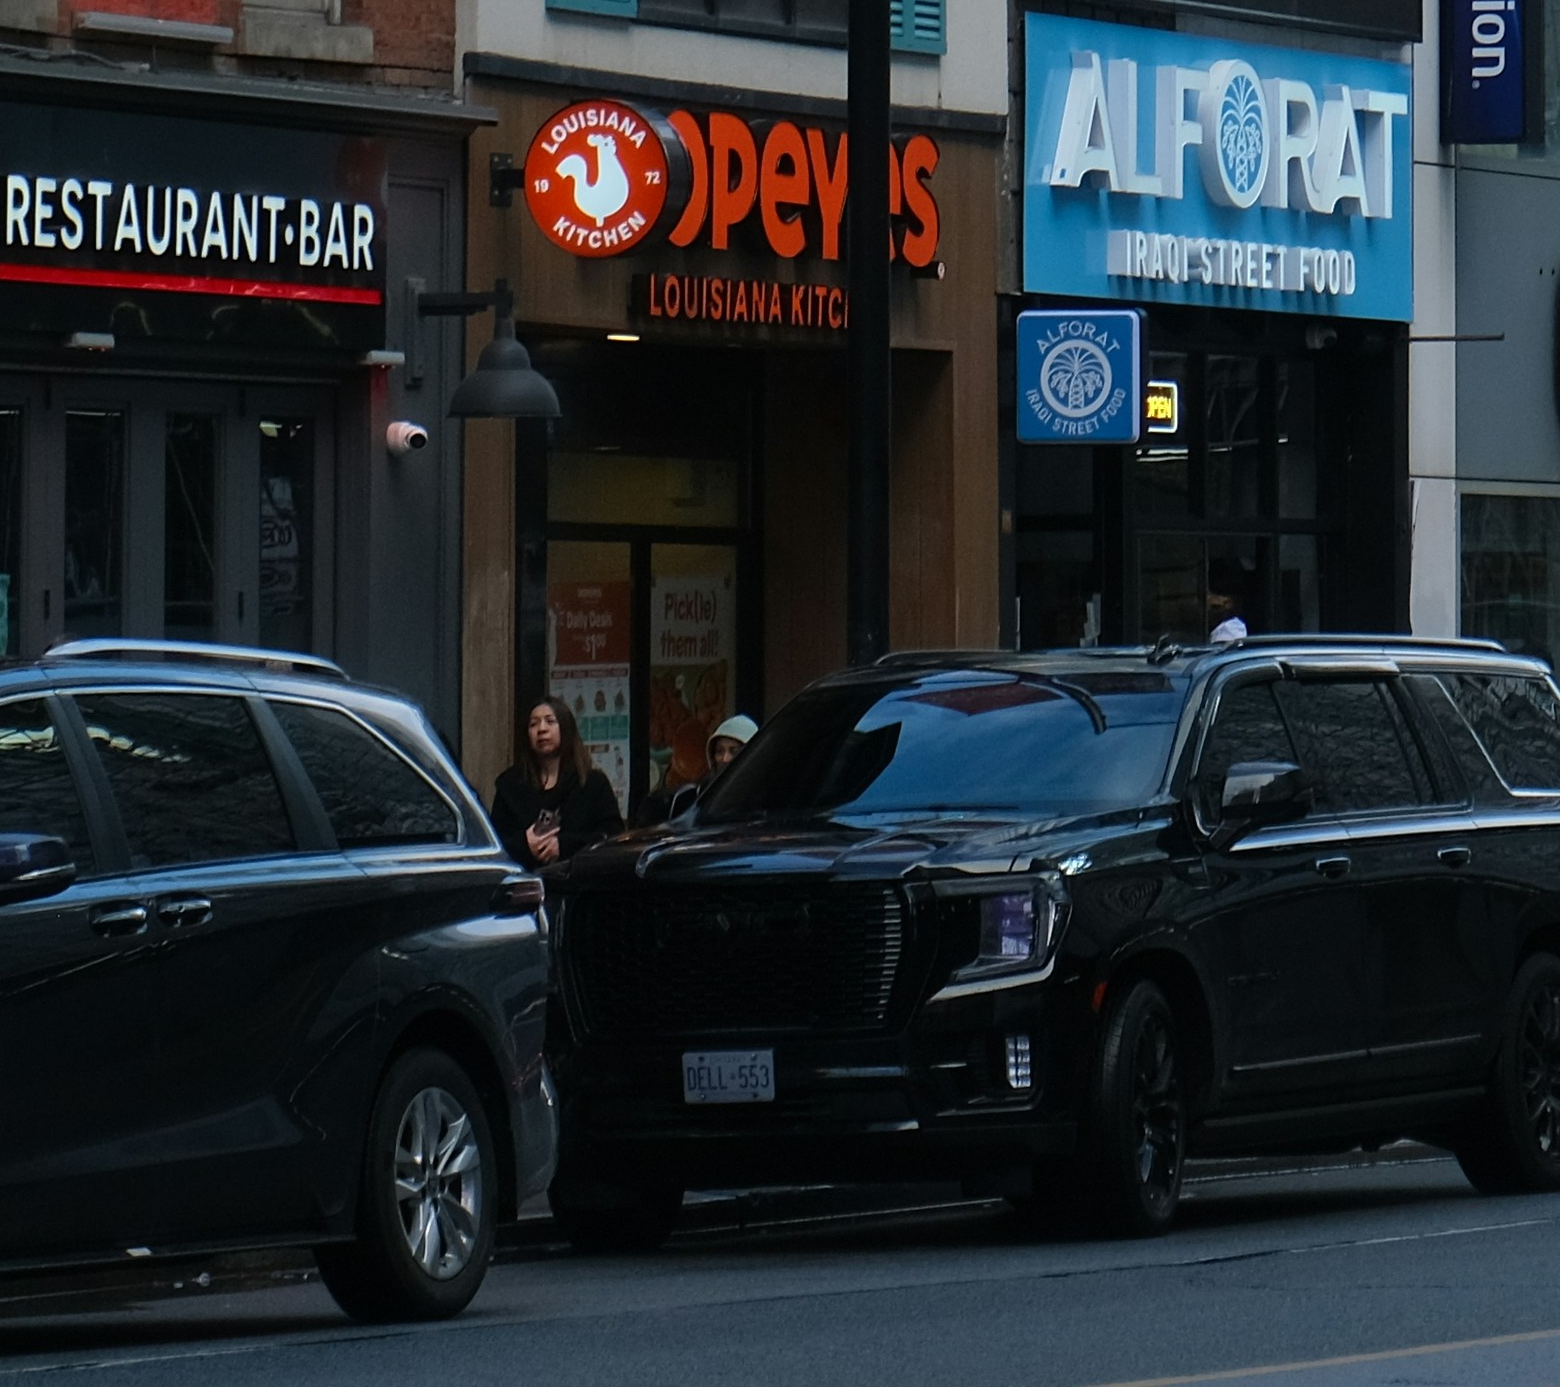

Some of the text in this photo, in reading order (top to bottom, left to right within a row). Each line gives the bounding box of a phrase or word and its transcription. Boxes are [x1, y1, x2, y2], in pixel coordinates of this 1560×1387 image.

[541, 108, 648, 154] LOUISIANA
[1047, 49, 1409, 221] ALFORAT
[534, 170, 661, 193] 19 72
[552, 210, 647, 249] KITCHEN
[1124, 229, 1358, 296] IRAQI STREET FOOD
[648, 273, 848, 329] LOUISIANA KITC
[1036, 319, 1121, 356] ALFORAT
[1024, 387, 1128, 437] IRAQI STREET FOOD
[664, 589, 717, 626] Pick(le)
[660, 633, 698, 658] them
[687, 1064, 770, 1092] DELL 553
